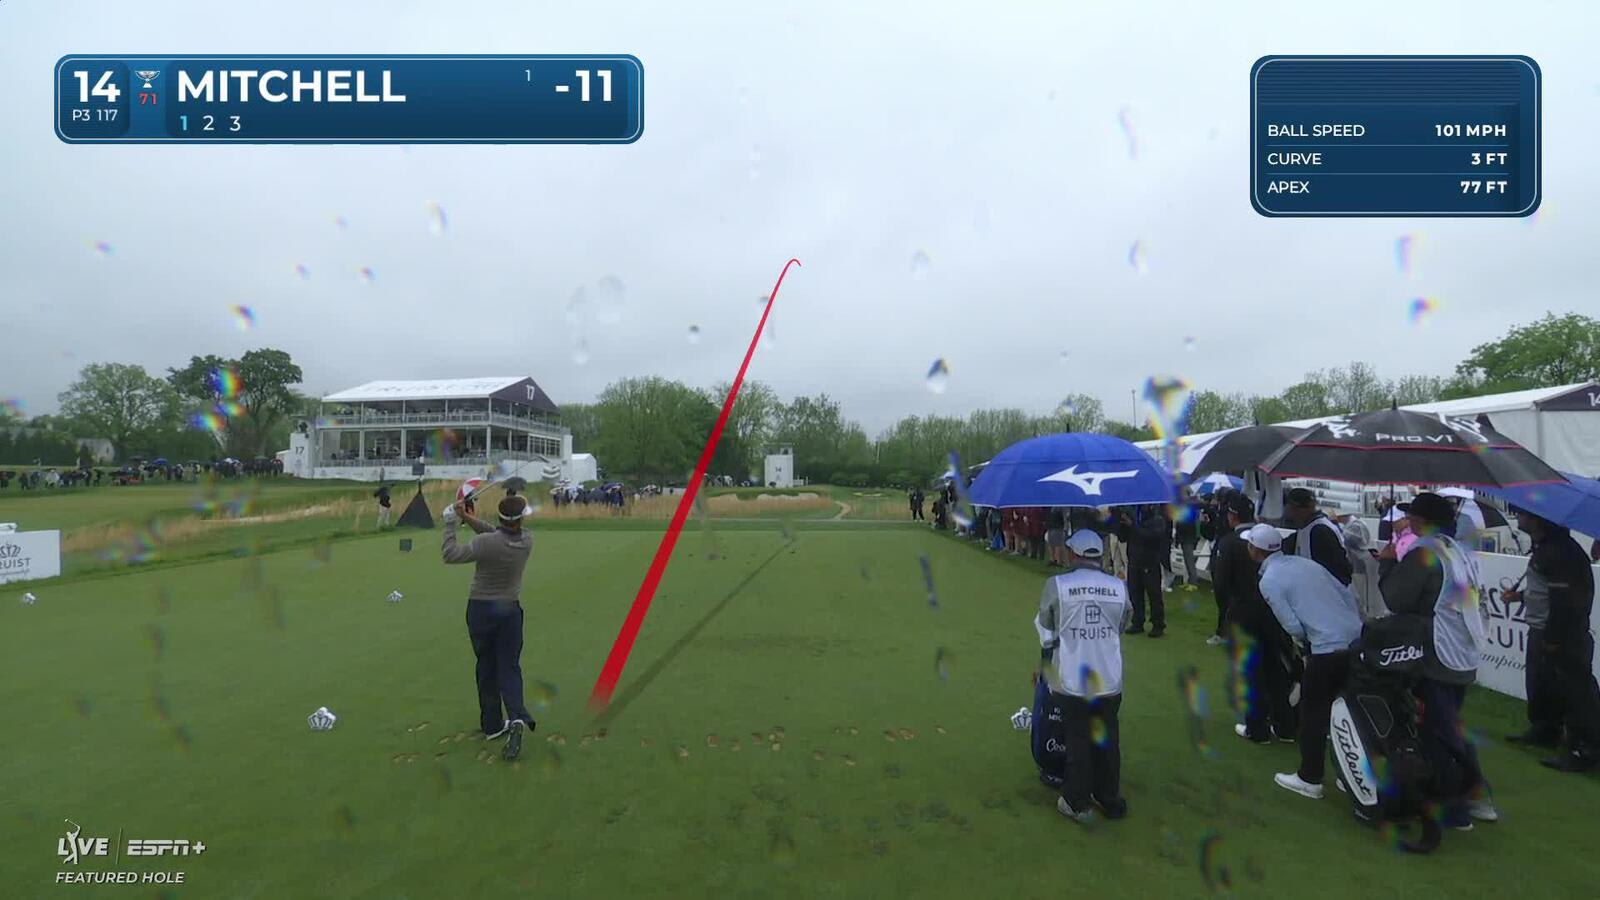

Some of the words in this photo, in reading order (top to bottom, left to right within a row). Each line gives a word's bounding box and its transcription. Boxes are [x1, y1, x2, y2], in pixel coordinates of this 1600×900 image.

[526, 384, 535, 400] 17
[1068, 586, 1119, 597] MITCHELL
[1070, 626, 1113, 640] TRUIST
[1333, 717, 1373, 798] Titleist
